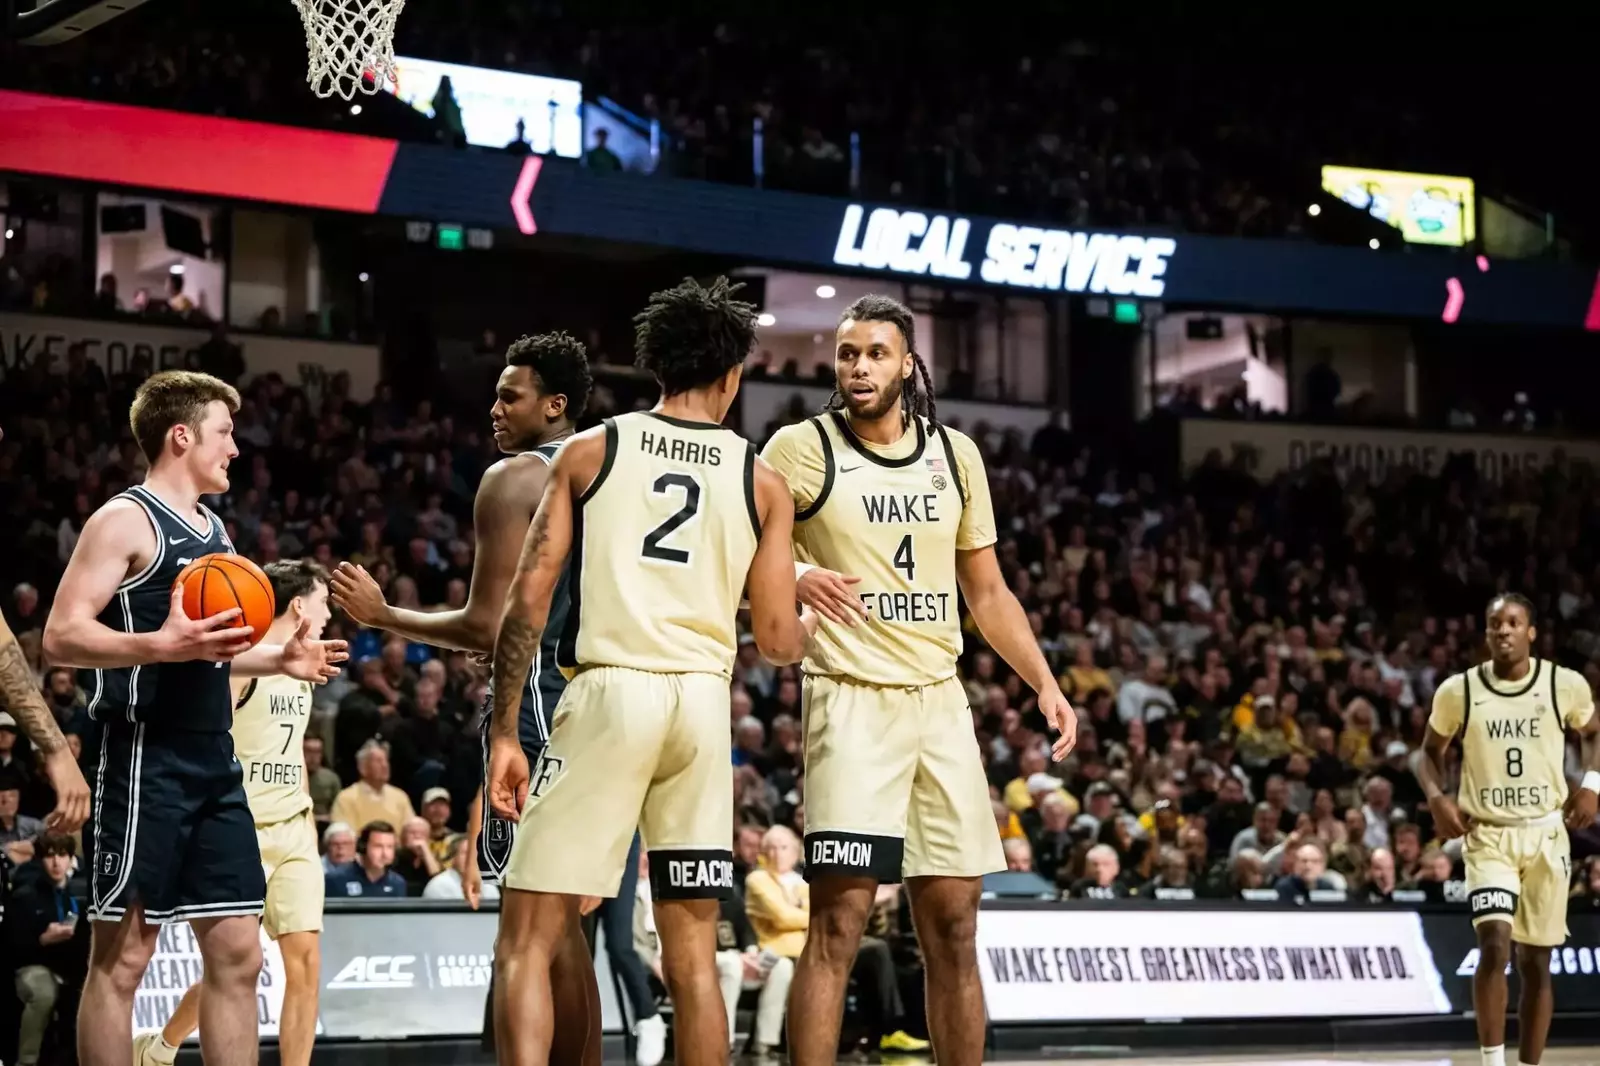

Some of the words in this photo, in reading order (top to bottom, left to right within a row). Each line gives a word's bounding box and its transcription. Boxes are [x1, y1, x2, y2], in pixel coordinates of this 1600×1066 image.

[834, 204, 972, 279] LOCAL
[980, 223, 1176, 297] SERVICE
[640, 431, 721, 466] HARRIS
[641, 472, 700, 563] 2
[862, 494, 940, 523] WAKE
[893, 534, 915, 581] 4
[860, 592, 949, 622] FOREST
[270, 694, 305, 716] WAKE
[280, 724, 294, 755] 7
[1486, 718, 1540, 739] WAKE
[249, 762, 302, 785] FOREST
[1506, 747, 1523, 778] 8
[1480, 786, 1549, 808] FOREST
[812, 840, 872, 867] DEMON
[1472, 891, 1513, 912] DEMON
[328, 954, 416, 987] ACC
[986, 947, 1052, 983] WAKE
[1053, 947, 1140, 983] FOREST.
[1140, 947, 1260, 982] GREATNESS
[1261, 946, 1284, 981] IS
[1284, 947, 1342, 981] WHAT
[1342, 946, 1377, 980] WE
